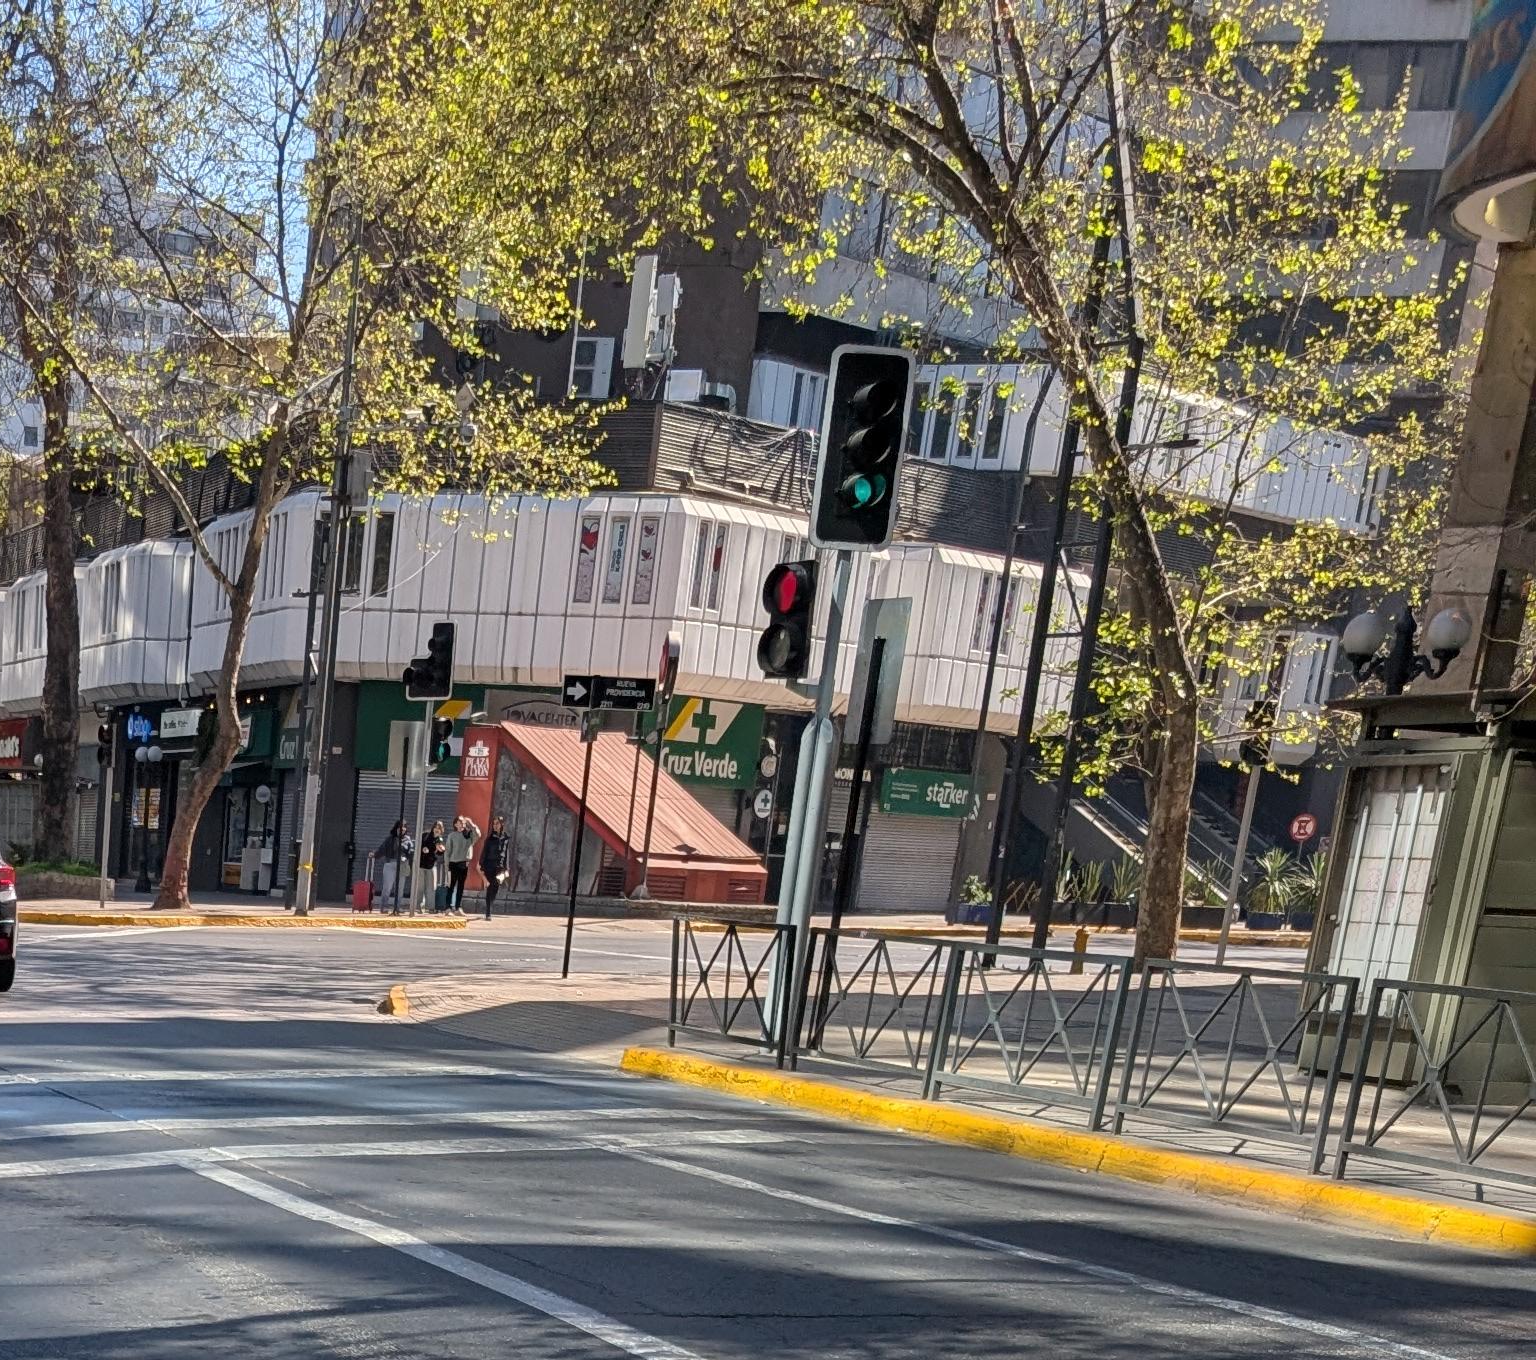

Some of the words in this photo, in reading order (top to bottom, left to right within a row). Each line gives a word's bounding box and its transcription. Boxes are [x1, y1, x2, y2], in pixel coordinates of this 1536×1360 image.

[606, 689, 645, 698] PROVIDENCIA
[659, 747, 693, 775] Cruz
[695, 751, 737, 779] Verde
[926, 782, 969, 807] starker
